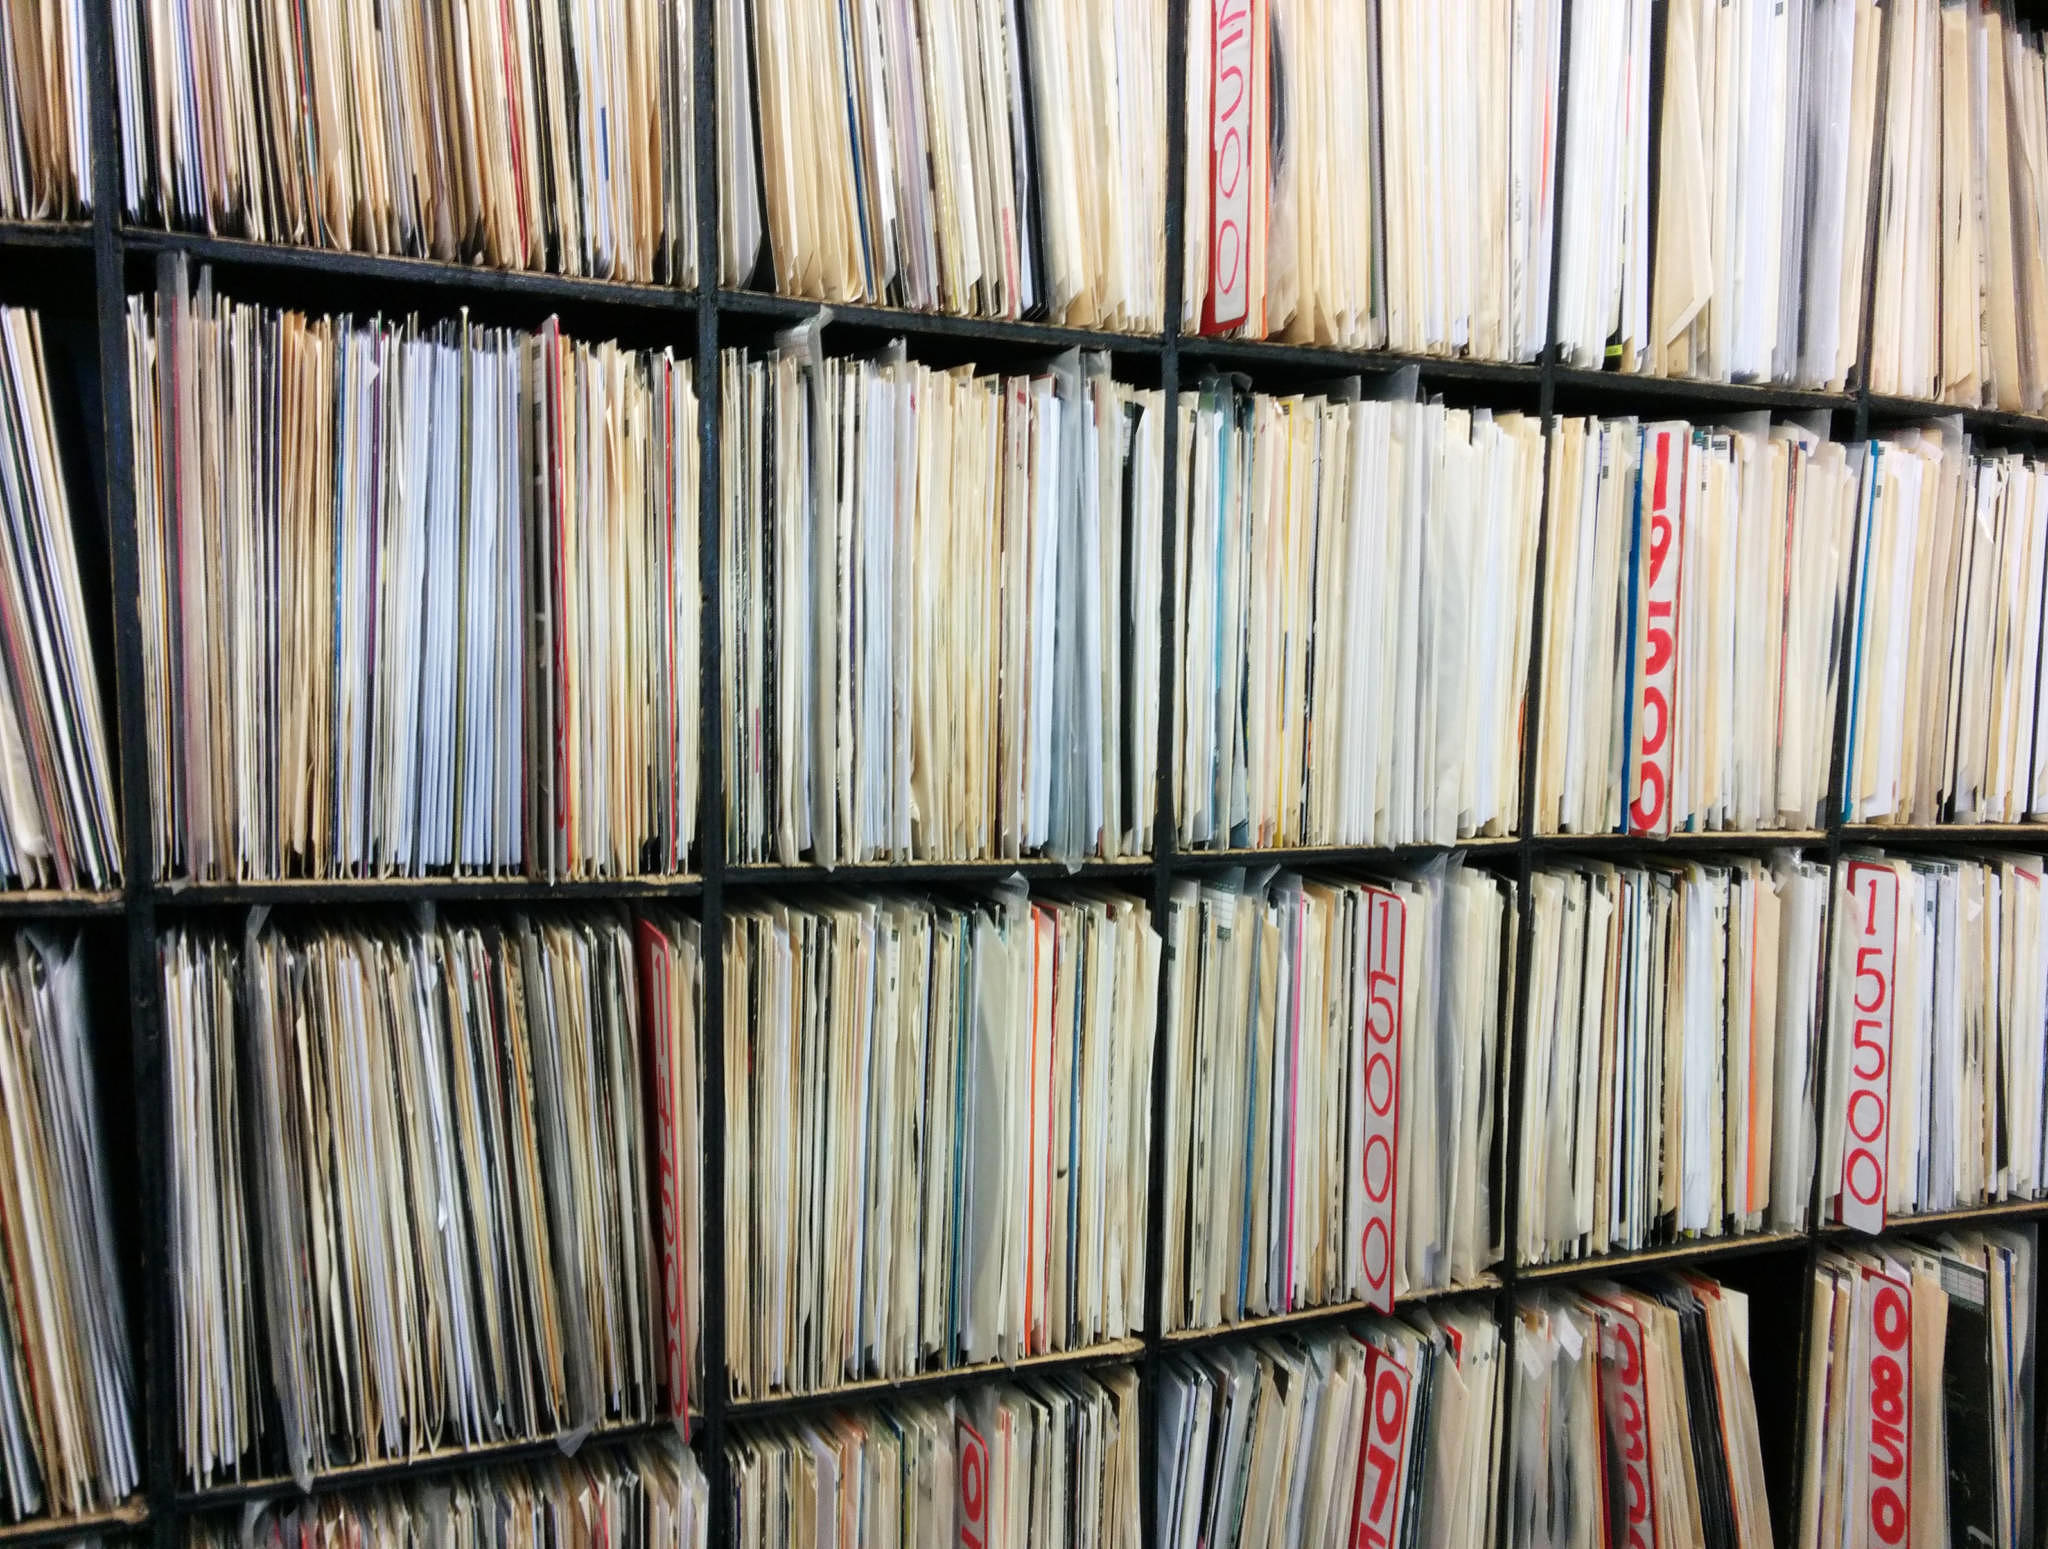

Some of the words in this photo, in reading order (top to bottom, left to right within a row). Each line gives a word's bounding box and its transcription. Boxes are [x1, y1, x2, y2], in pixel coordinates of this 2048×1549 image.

[1361, 900, 1397, 1290] 15000
[1846, 879, 1887, 1206] 15500
[1870, 1286, 1908, 1545] 0850
